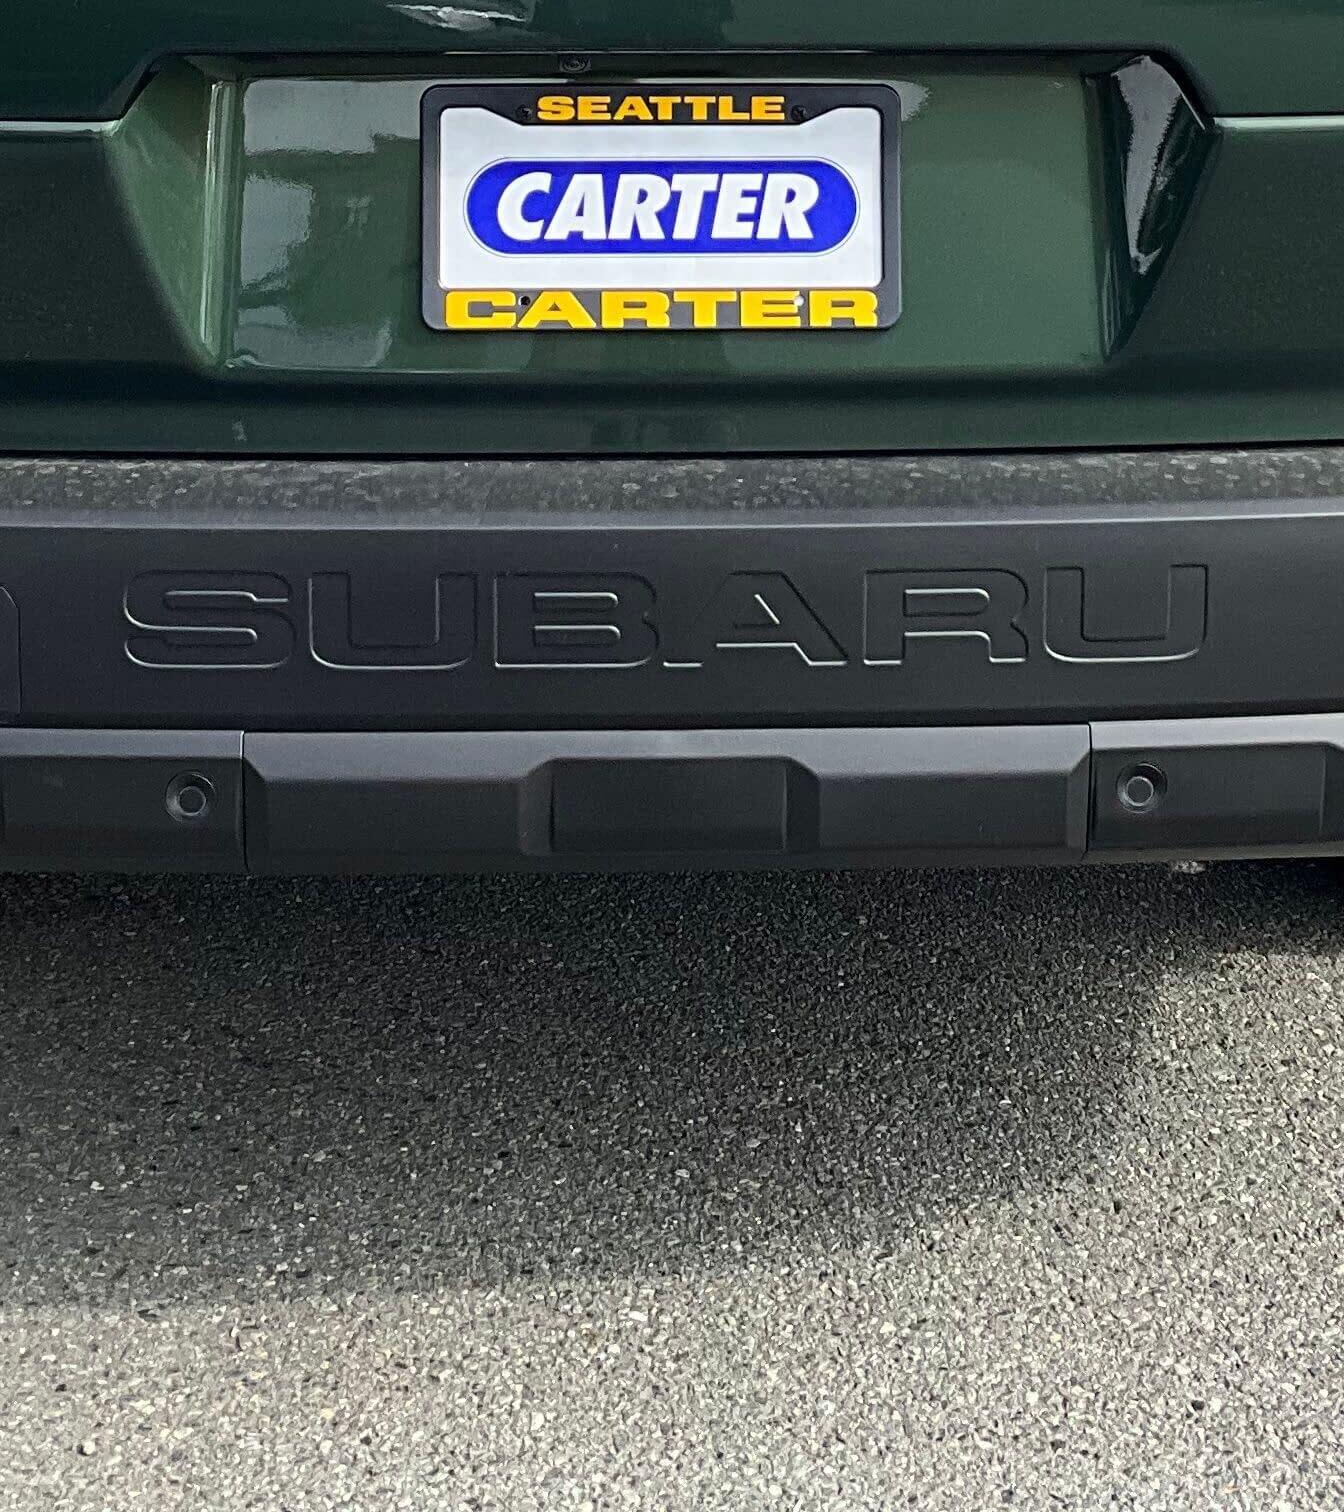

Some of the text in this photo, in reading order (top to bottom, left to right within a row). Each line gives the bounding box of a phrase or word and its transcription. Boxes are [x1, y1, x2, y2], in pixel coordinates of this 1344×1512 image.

[537, 95, 786, 122] SEATTLE
[496, 170, 820, 242] CARTER
[444, 288, 879, 330] CARTER
[122, 564, 1209, 670] SUBARU
